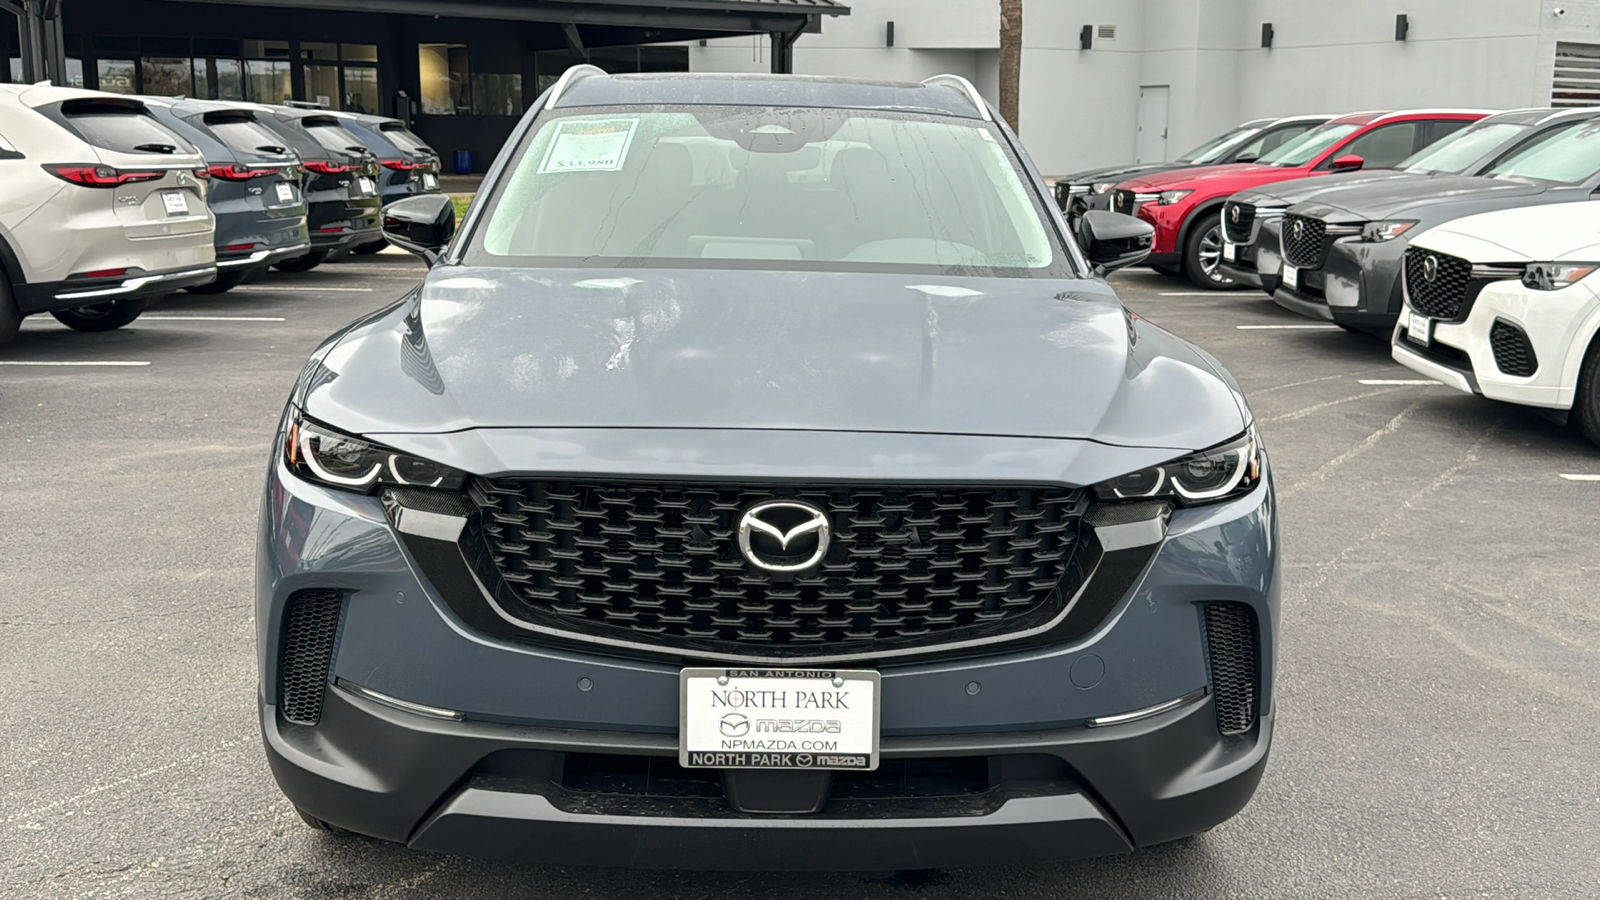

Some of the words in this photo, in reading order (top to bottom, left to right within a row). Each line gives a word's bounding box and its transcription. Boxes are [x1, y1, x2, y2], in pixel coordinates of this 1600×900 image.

[765, 670, 832, 678] ANTONIO
[711, 690, 787, 708] NORTH
[795, 691, 850, 709] PARK
[721, 740, 837, 751] NPMAZDA.COM
[692, 753, 746, 765] NORTH
[751, 753, 792, 766] PARK
